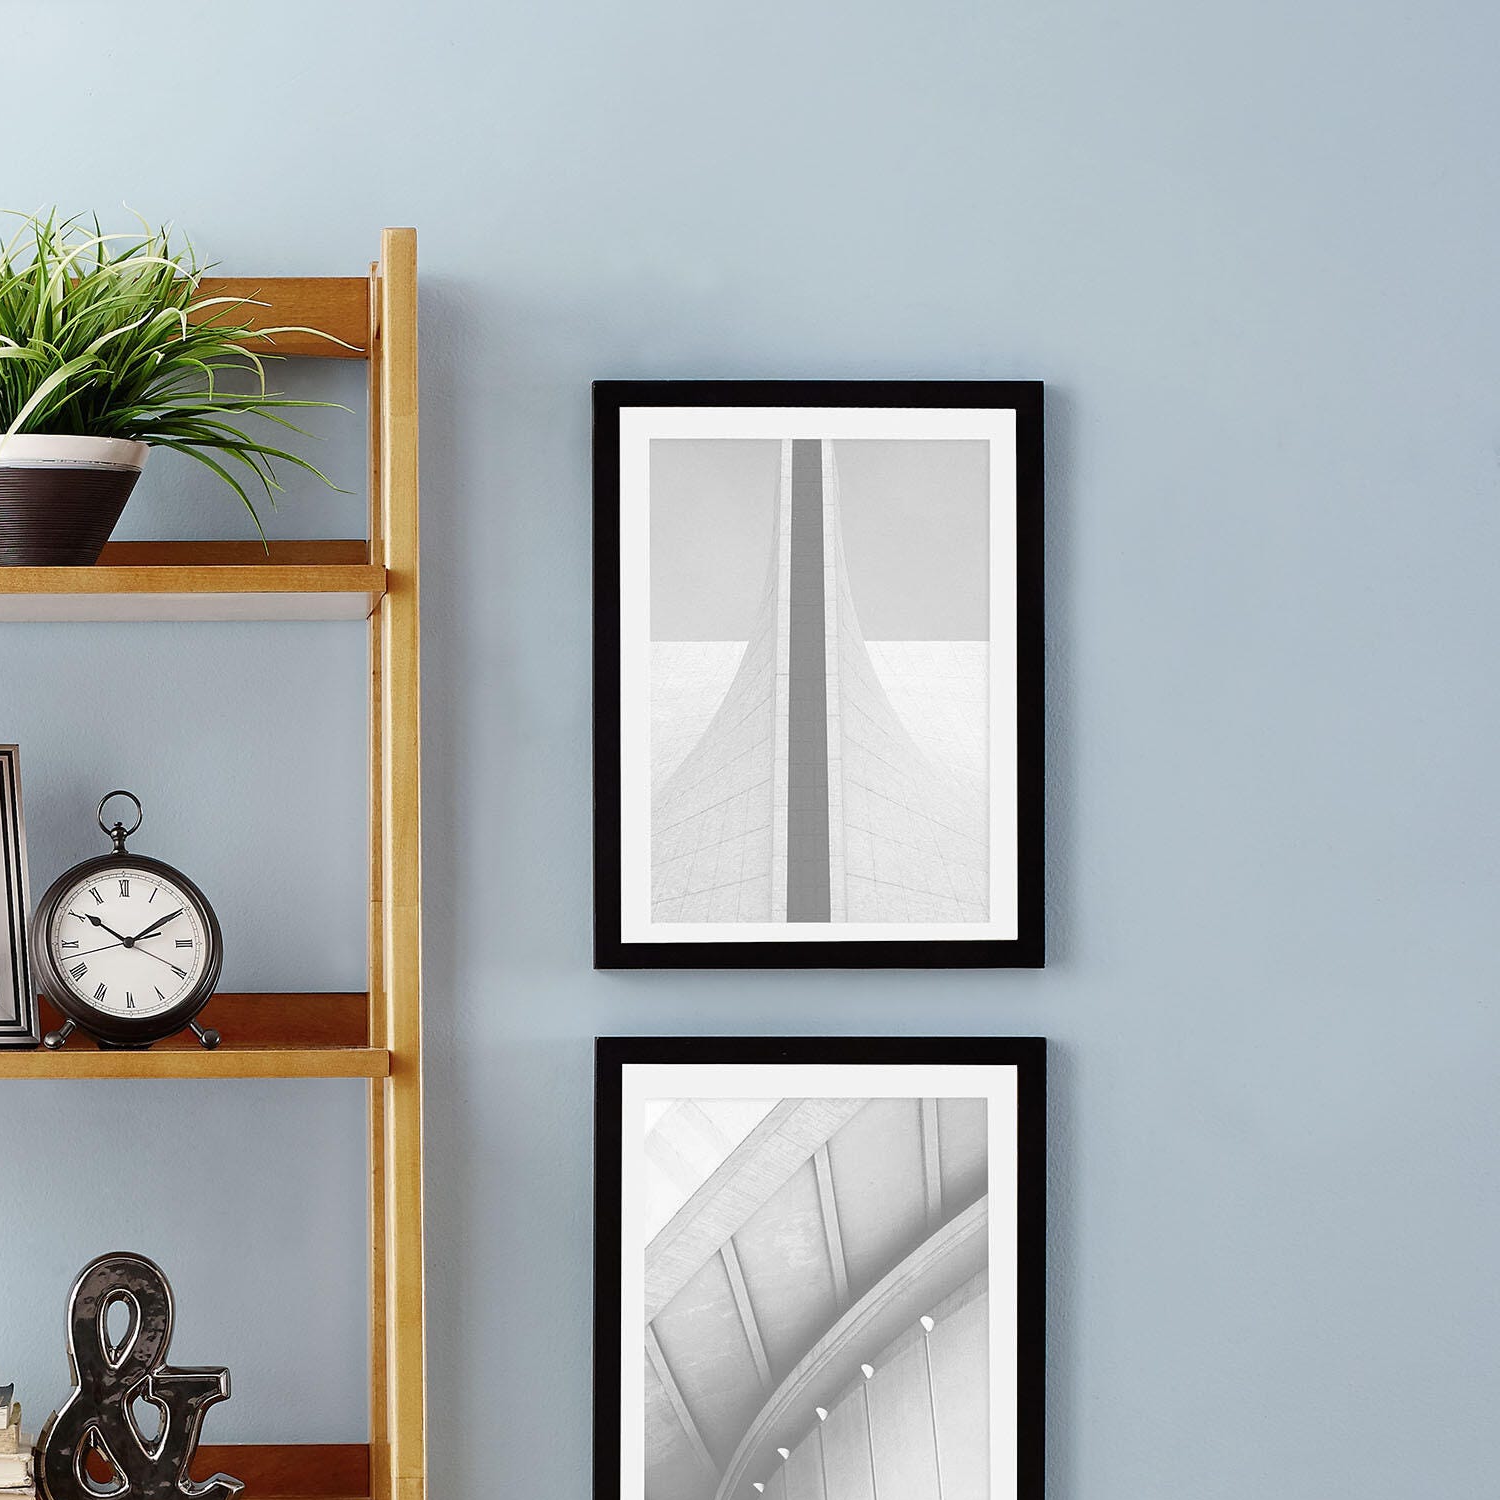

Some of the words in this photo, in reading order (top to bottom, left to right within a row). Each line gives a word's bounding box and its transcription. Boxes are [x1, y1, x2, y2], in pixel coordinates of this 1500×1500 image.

[89, 887, 104, 905] XI
[118, 879, 130, 897] XII
[148, 887, 158, 903] I
[68, 909, 86, 922] X
[61, 939, 79, 948] IX
[175, 939, 193, 948] III
[69, 961, 88, 982] VIII
[170, 964, 187, 980] IV
[93, 982, 108, 1002] VII
[126, 991, 136, 1008] VI
[154, 985, 166, 1001] V
